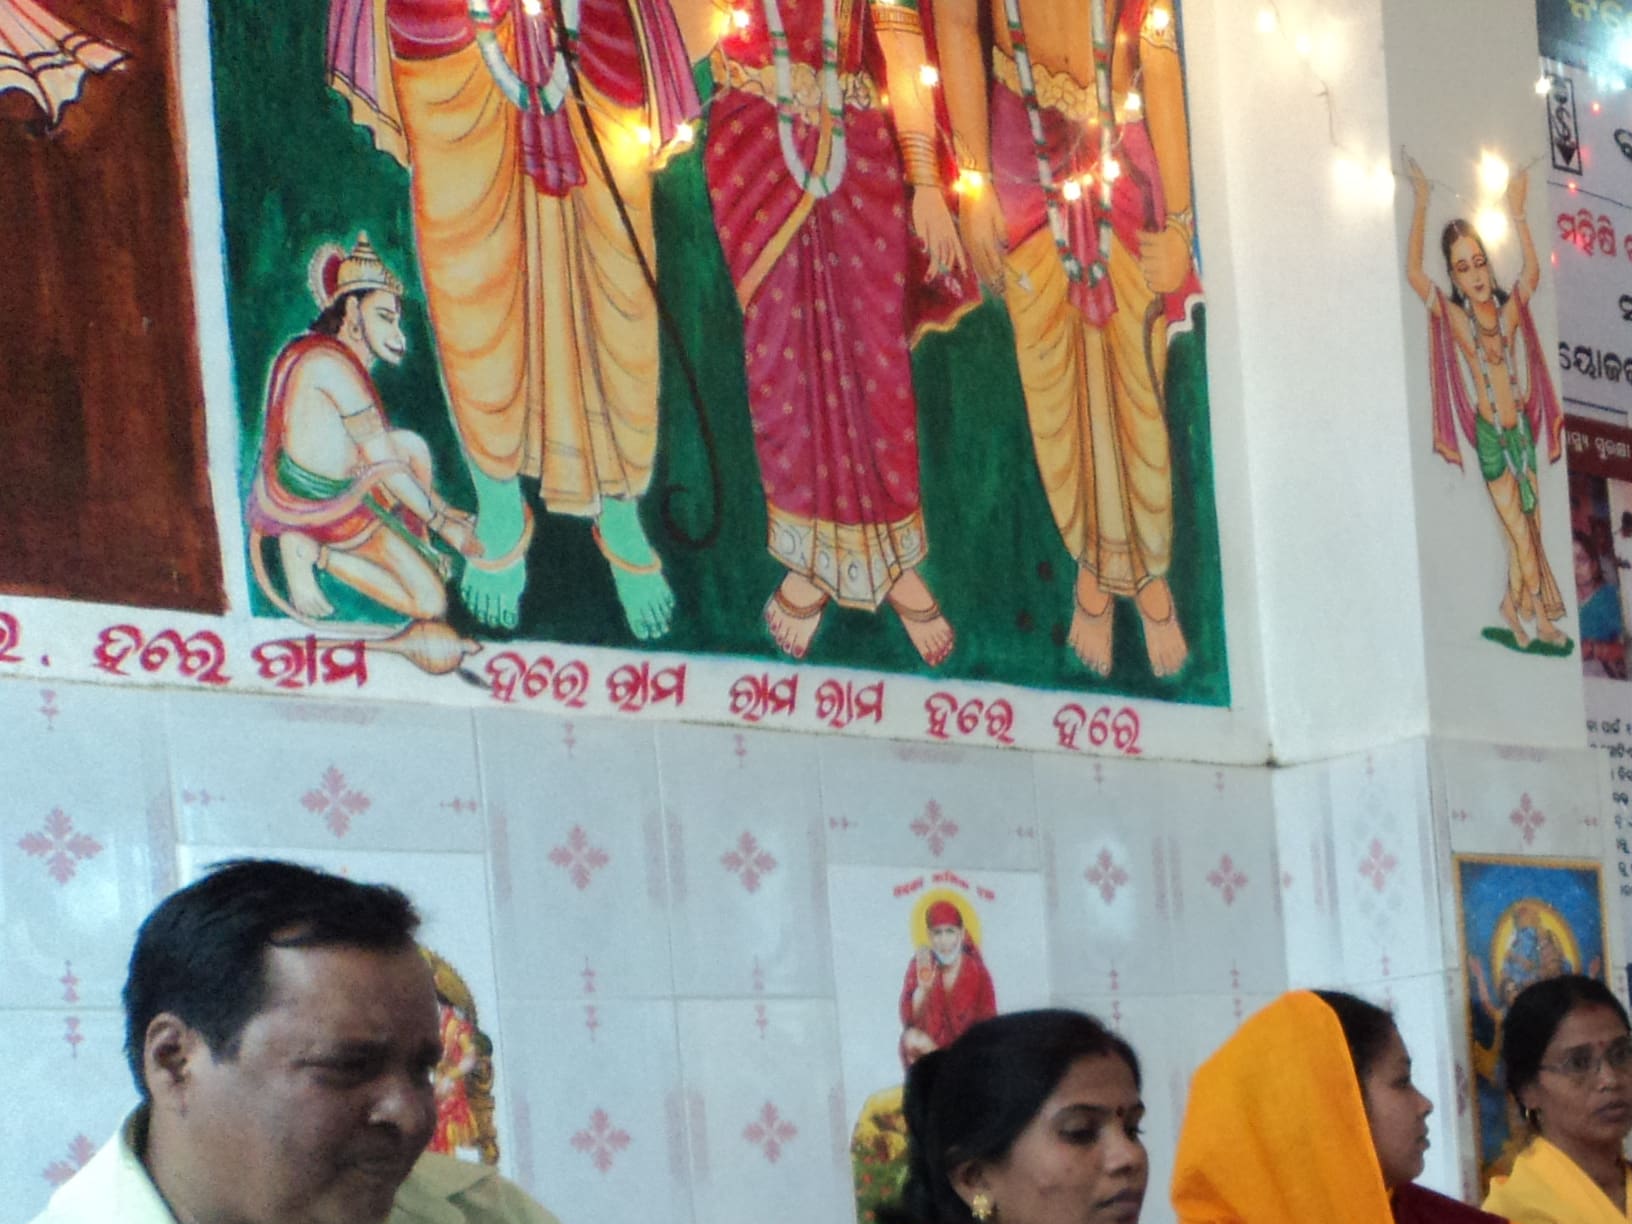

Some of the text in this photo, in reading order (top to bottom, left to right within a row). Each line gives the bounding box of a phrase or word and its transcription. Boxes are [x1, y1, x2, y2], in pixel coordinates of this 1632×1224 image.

[92, 623, 1143, 755] ହରେ ରାମ ହରେ ରାମ ରାମ ରାମ ହରେ ହରେ
